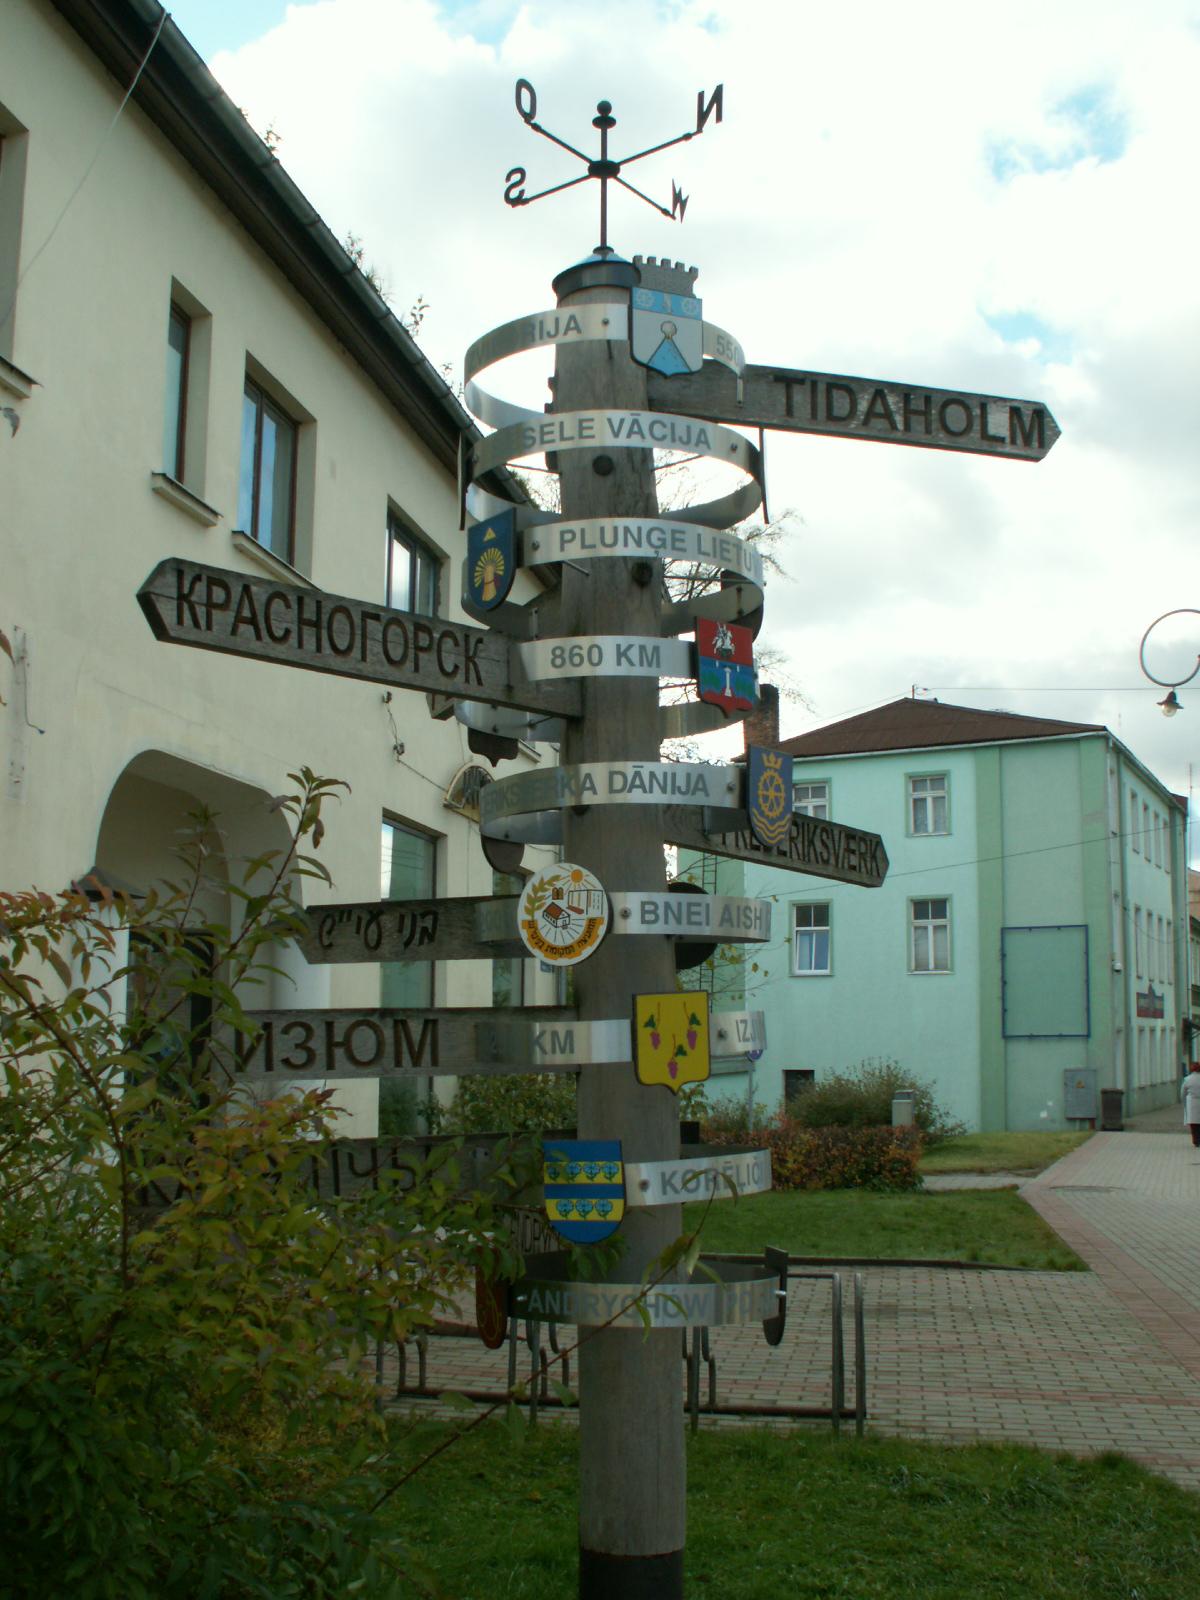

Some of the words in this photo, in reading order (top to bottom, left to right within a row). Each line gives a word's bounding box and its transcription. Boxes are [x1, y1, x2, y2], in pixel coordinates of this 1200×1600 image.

[773, 373, 1046, 449] TIDAHOLM
[606, 412, 712, 450] VĀCIJA
[173, 568, 486, 688] КРАСНОГОРСК
[549, 643, 603, 670] 860
[615, 643, 662, 670] KM
[608, 765, 710, 798] DĀNIJA
[640, 900, 711, 927] BNEI
[719, 903, 762, 931] AISH
[235, 1017, 440, 1073] ИЗЮМ
